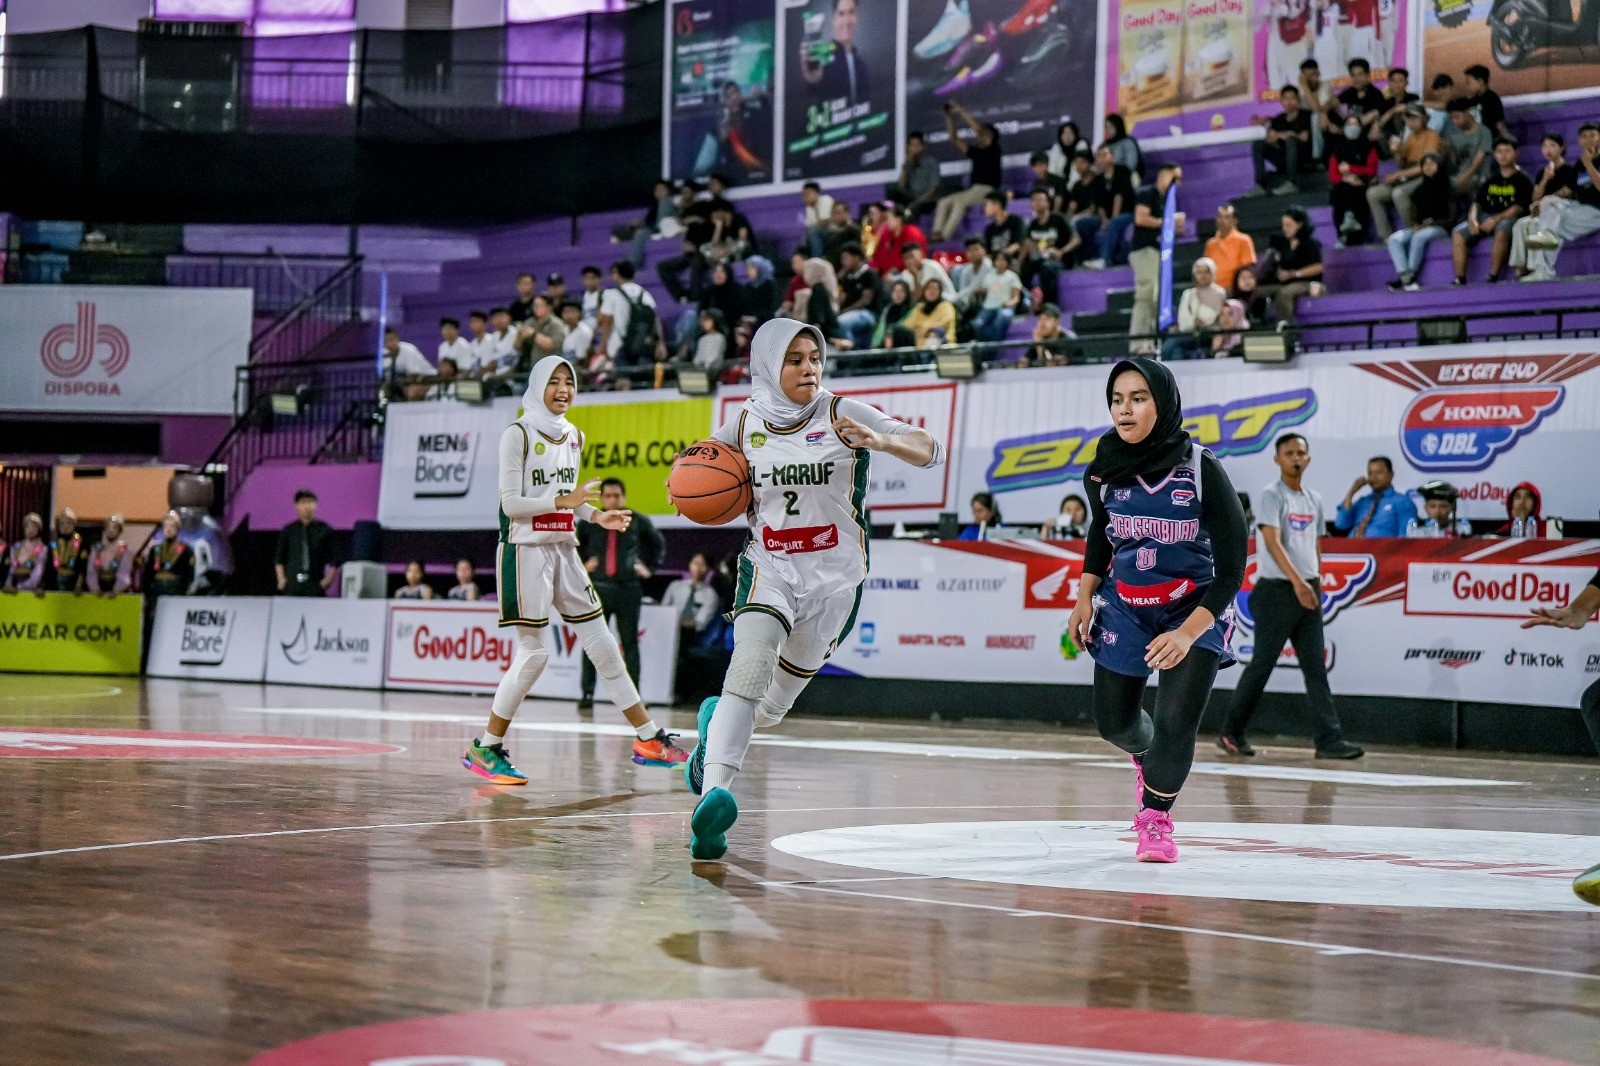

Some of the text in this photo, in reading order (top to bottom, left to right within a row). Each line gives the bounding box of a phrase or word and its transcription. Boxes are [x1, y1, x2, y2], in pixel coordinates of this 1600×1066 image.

[1471, 362, 1502, 380] GET
[1500, 361, 1540, 380] LOUD
[45, 381, 121, 396] DISPORA
[1443, 404, 1524, 421] HONDA
[1438, 432, 1479, 456] DBL
[415, 455, 467, 483] Bioré
[783, 491, 800, 515] 2
[1133, 516, 1199, 544] SEMBILAN
[1136, 547, 1157, 570] 8
[181, 628, 223, 652] Bioré
[314, 628, 370, 652] Jackson
